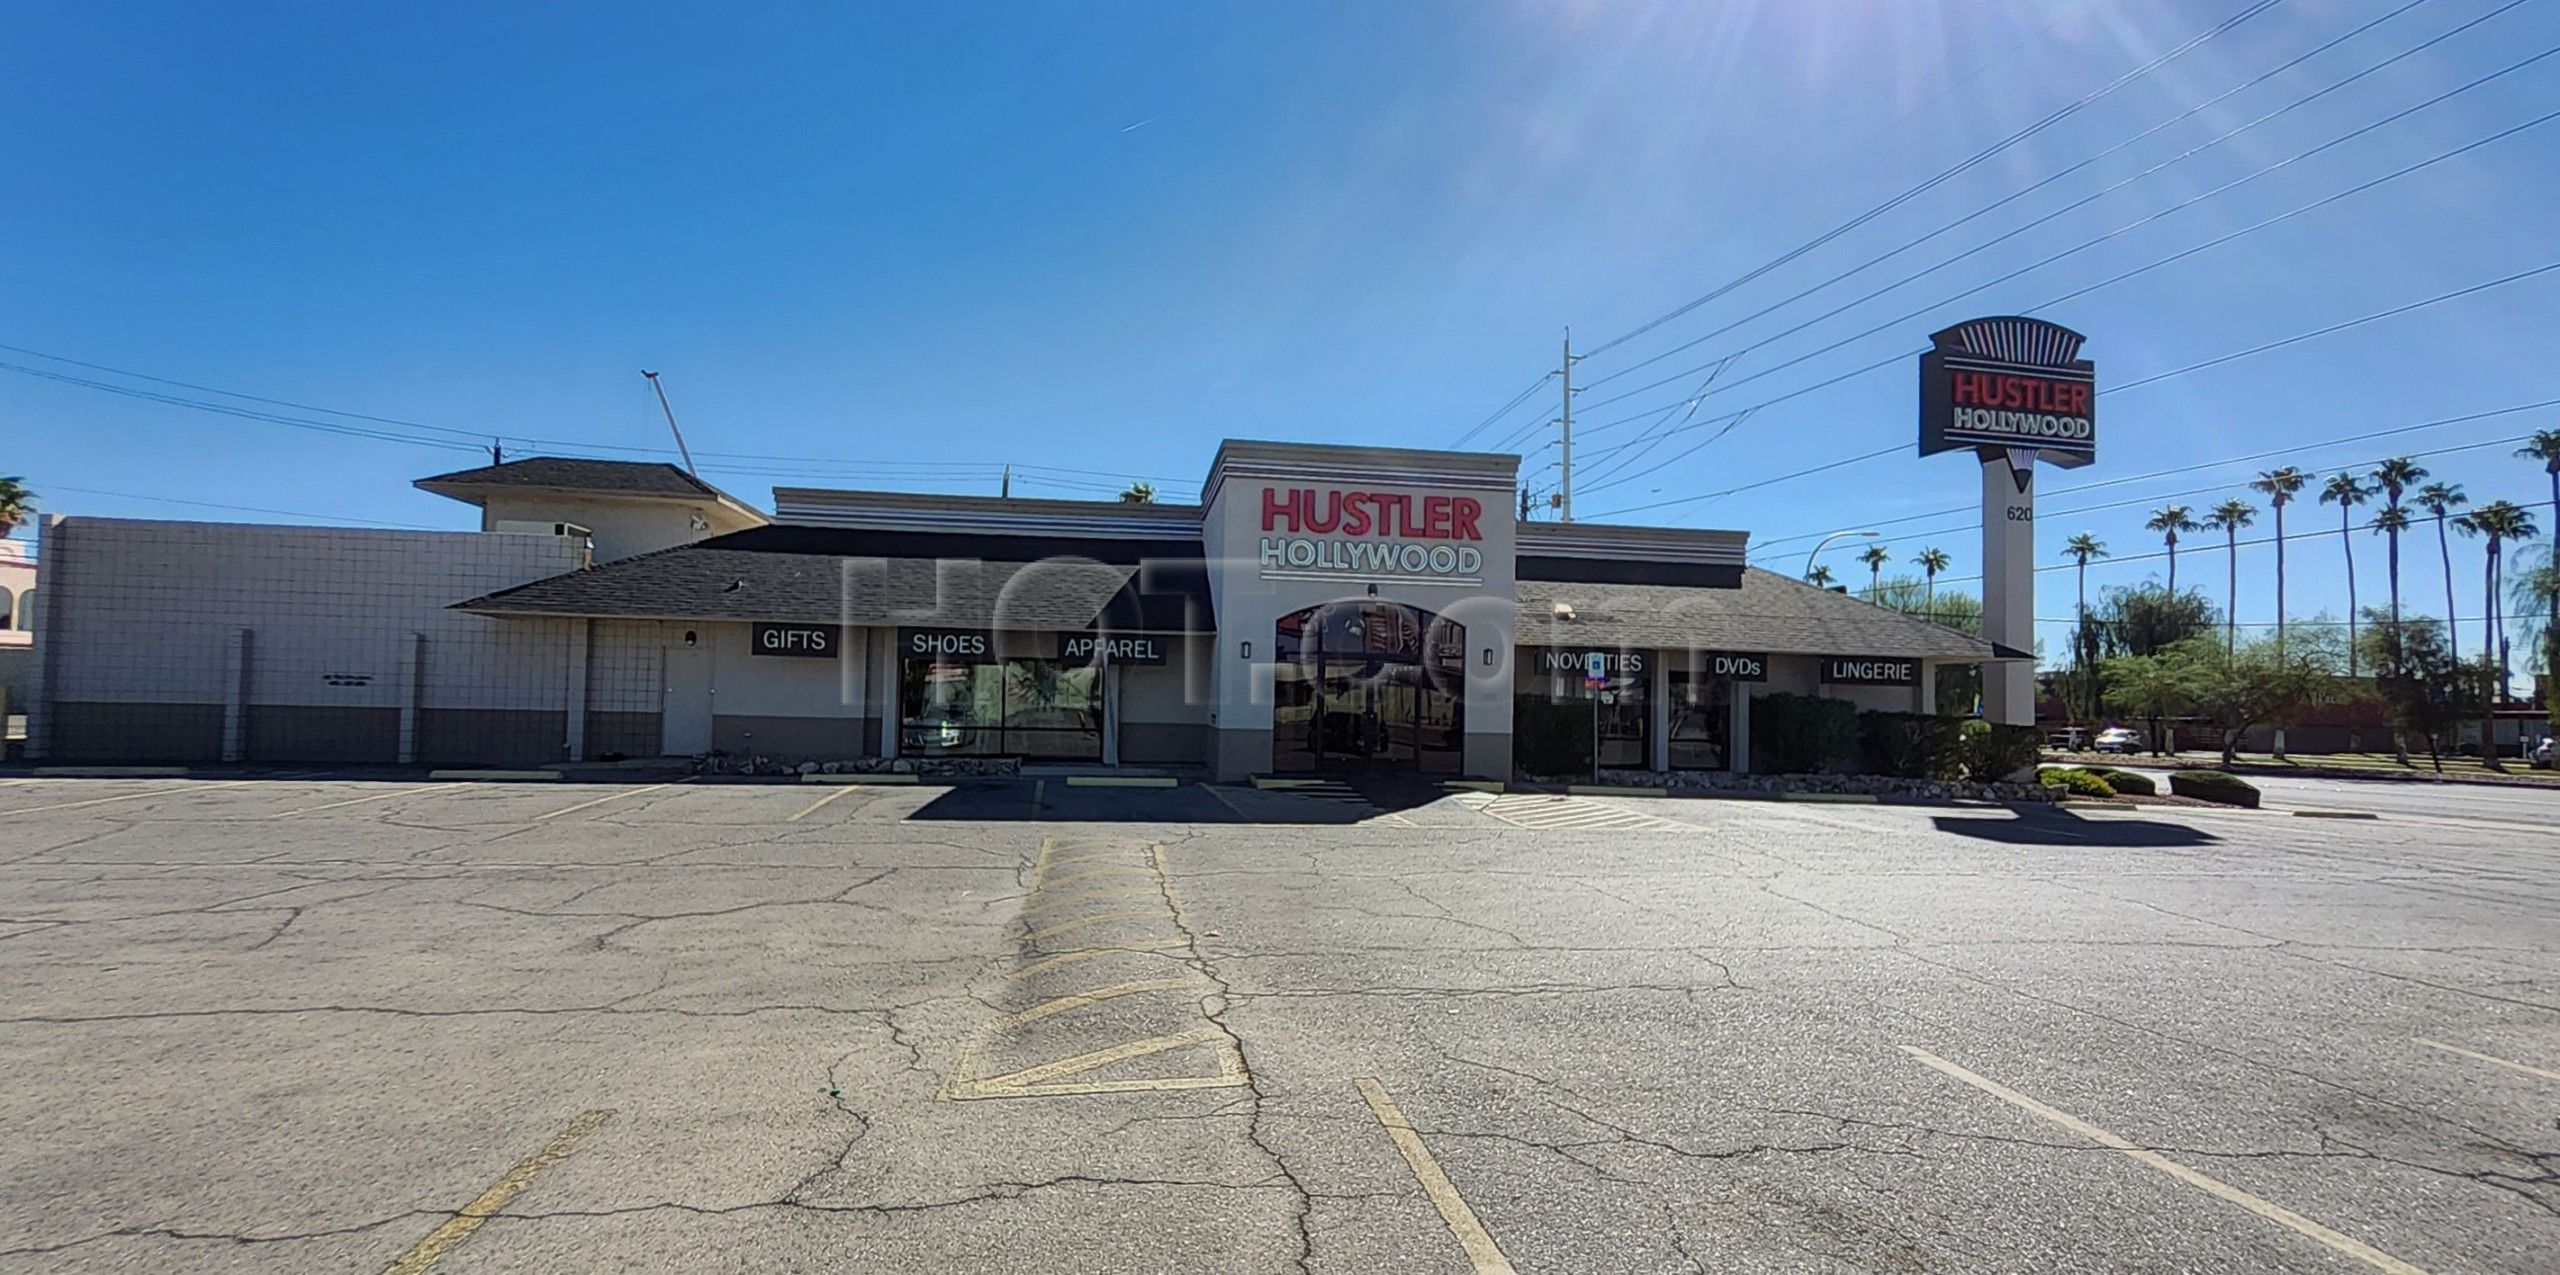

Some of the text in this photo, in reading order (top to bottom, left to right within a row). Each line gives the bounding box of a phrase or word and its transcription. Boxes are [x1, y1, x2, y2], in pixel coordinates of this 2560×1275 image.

[1954, 373, 2088, 413] HUSTLER
[1953, 407, 2090, 438] HOLLYWOOD
[1261, 488, 1483, 541] HUSTLER
[2007, 505, 2033, 521] 620
[1261, 538, 1482, 573] HOLLYWOOD
[762, 629, 827, 650] GIFTS
[912, 633, 985, 655] SHOES
[1065, 637, 1160, 660] APPAREL
[1546, 652, 1643, 672] NOVTIES
[1715, 656, 1761, 676] DVDs
[1833, 661, 1912, 681] LINGERIE
